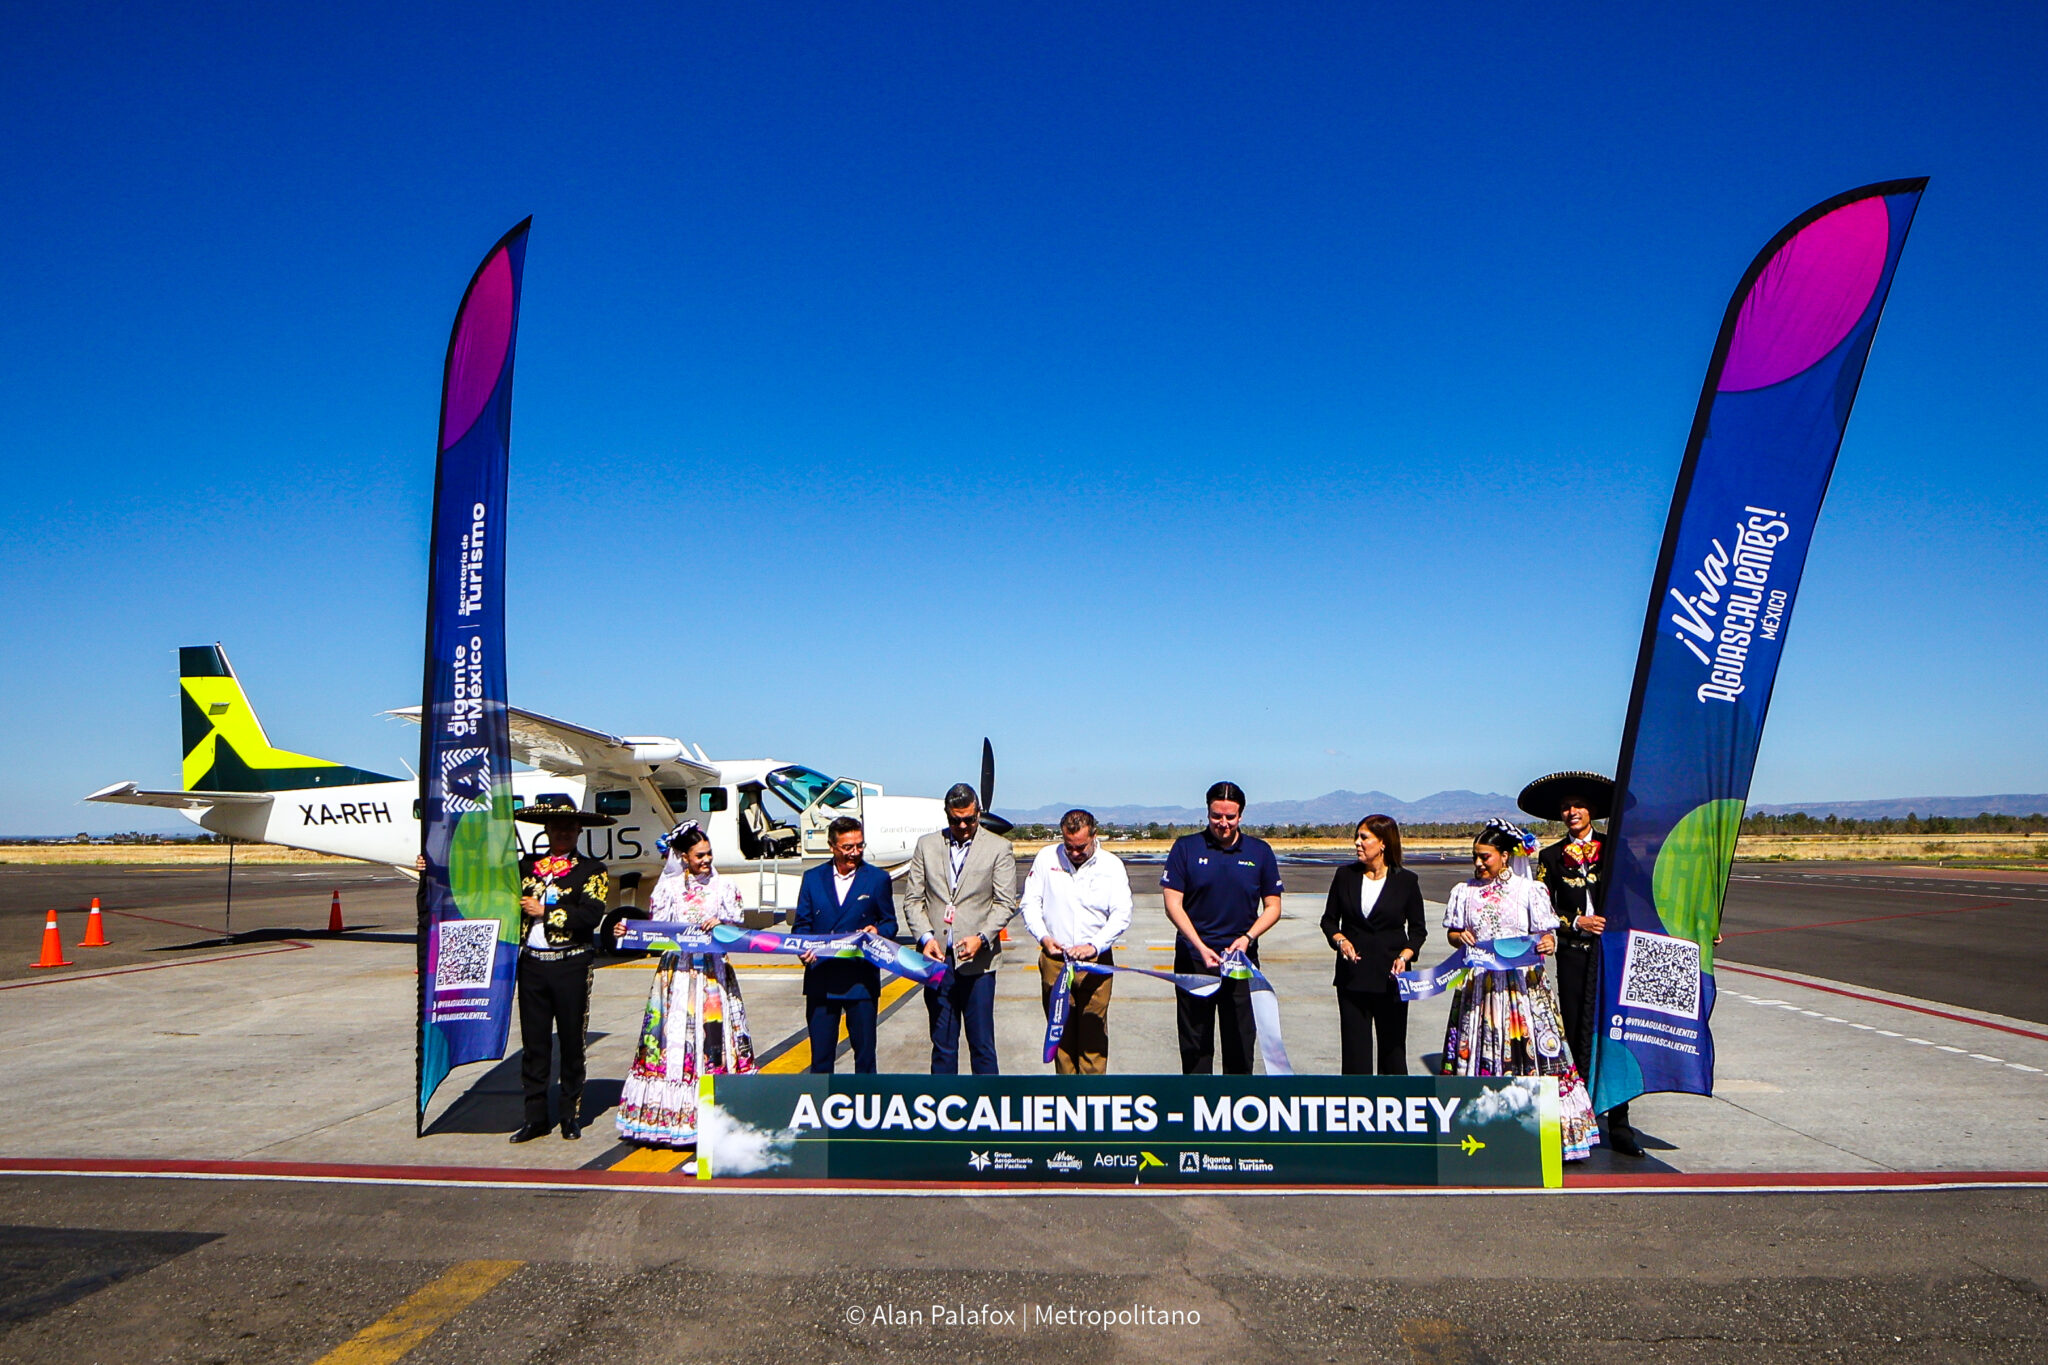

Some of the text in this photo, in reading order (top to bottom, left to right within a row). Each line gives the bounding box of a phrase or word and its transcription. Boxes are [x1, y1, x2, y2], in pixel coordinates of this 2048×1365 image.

[461, 534, 469, 550] de
[466, 502, 486, 616] Turismo
[1760, 590, 1788, 640] MÉXICO
[451, 644, 469, 737] gigante
[467, 635, 483, 735] de México
[298, 802, 392, 826] XA-RFH
[1624, 1017, 1698, 1040] @VIVAAGUASCALIENTES
[787, 1093, 1159, 1132] AGUASCALIENTES
[1193, 1095, 1461, 1133] MONTERREY
[994, 1157, 1034, 1165] Aeroportuario
[1093, 1152, 1138, 1167] Aerus
[1239, 1162, 1274, 1171] Turismo
